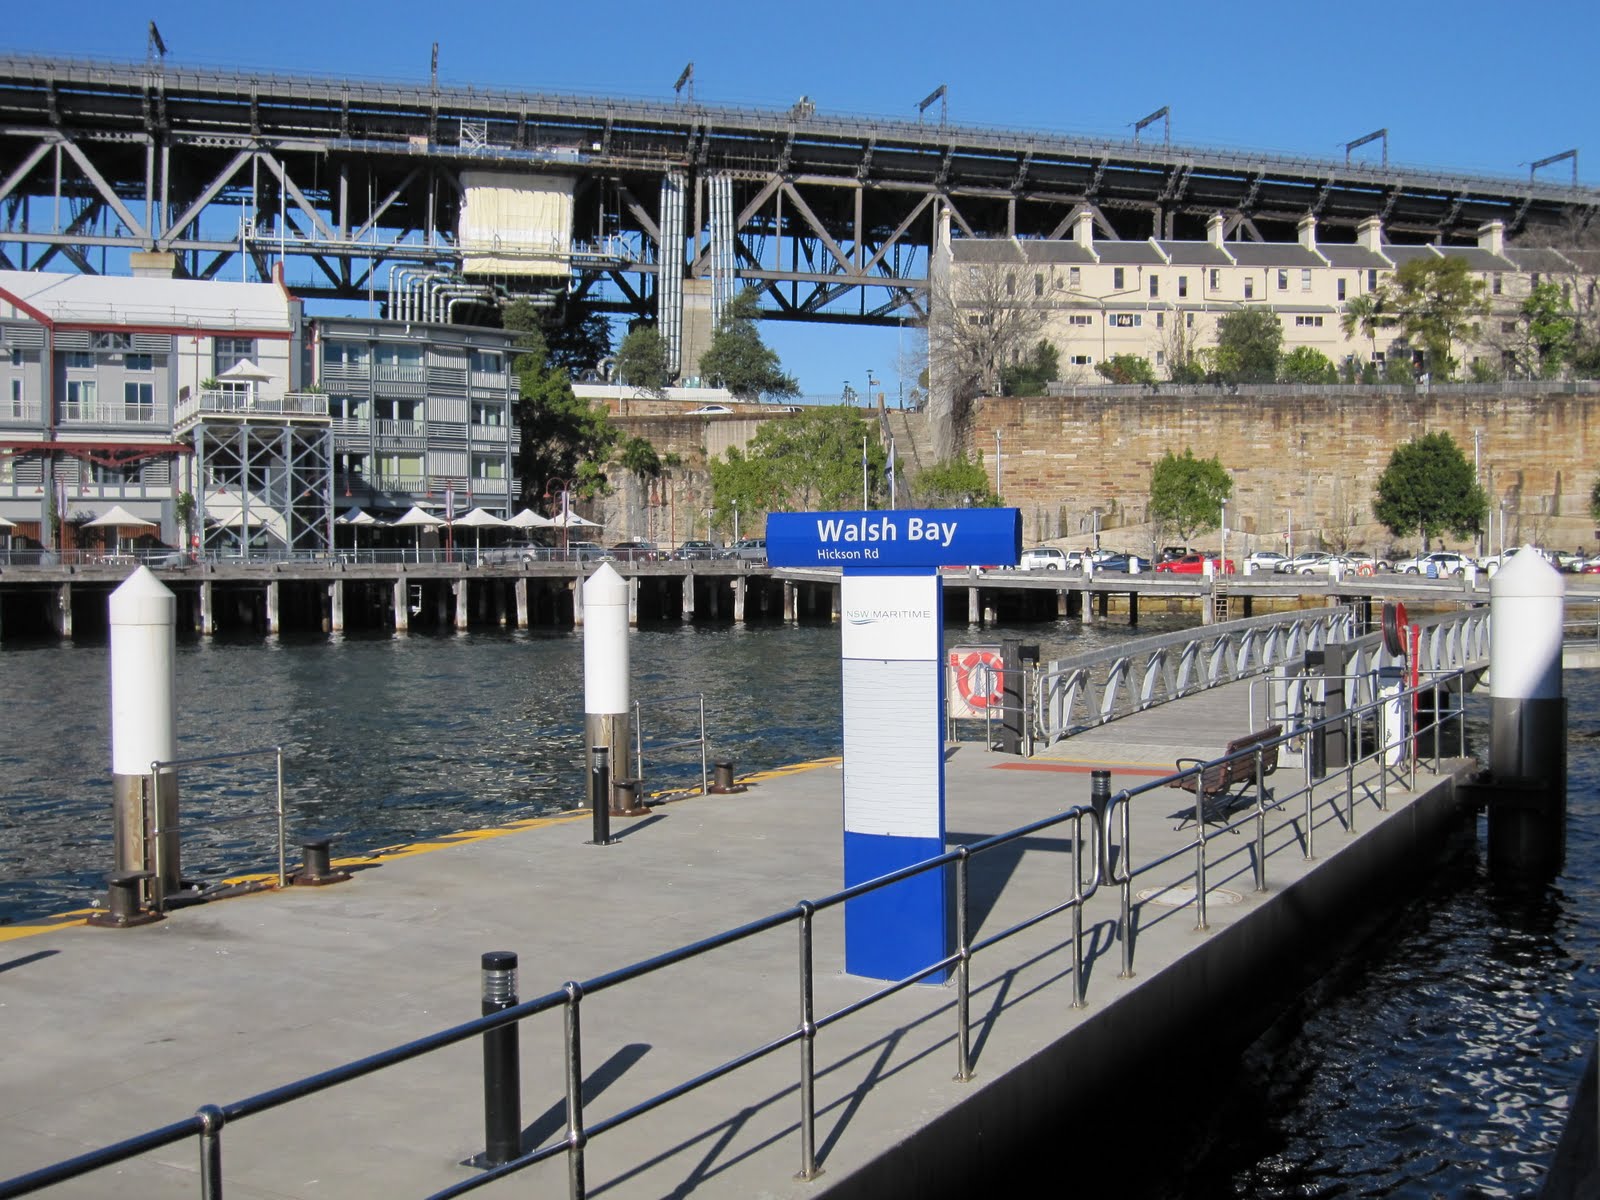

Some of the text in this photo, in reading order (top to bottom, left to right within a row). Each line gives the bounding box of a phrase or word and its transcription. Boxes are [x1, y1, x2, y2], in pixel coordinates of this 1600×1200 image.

[816, 516, 958, 547] Walsh Bay
[817, 548, 880, 560] Hickson Rd
[846, 610, 931, 618] NSW MARITIME
